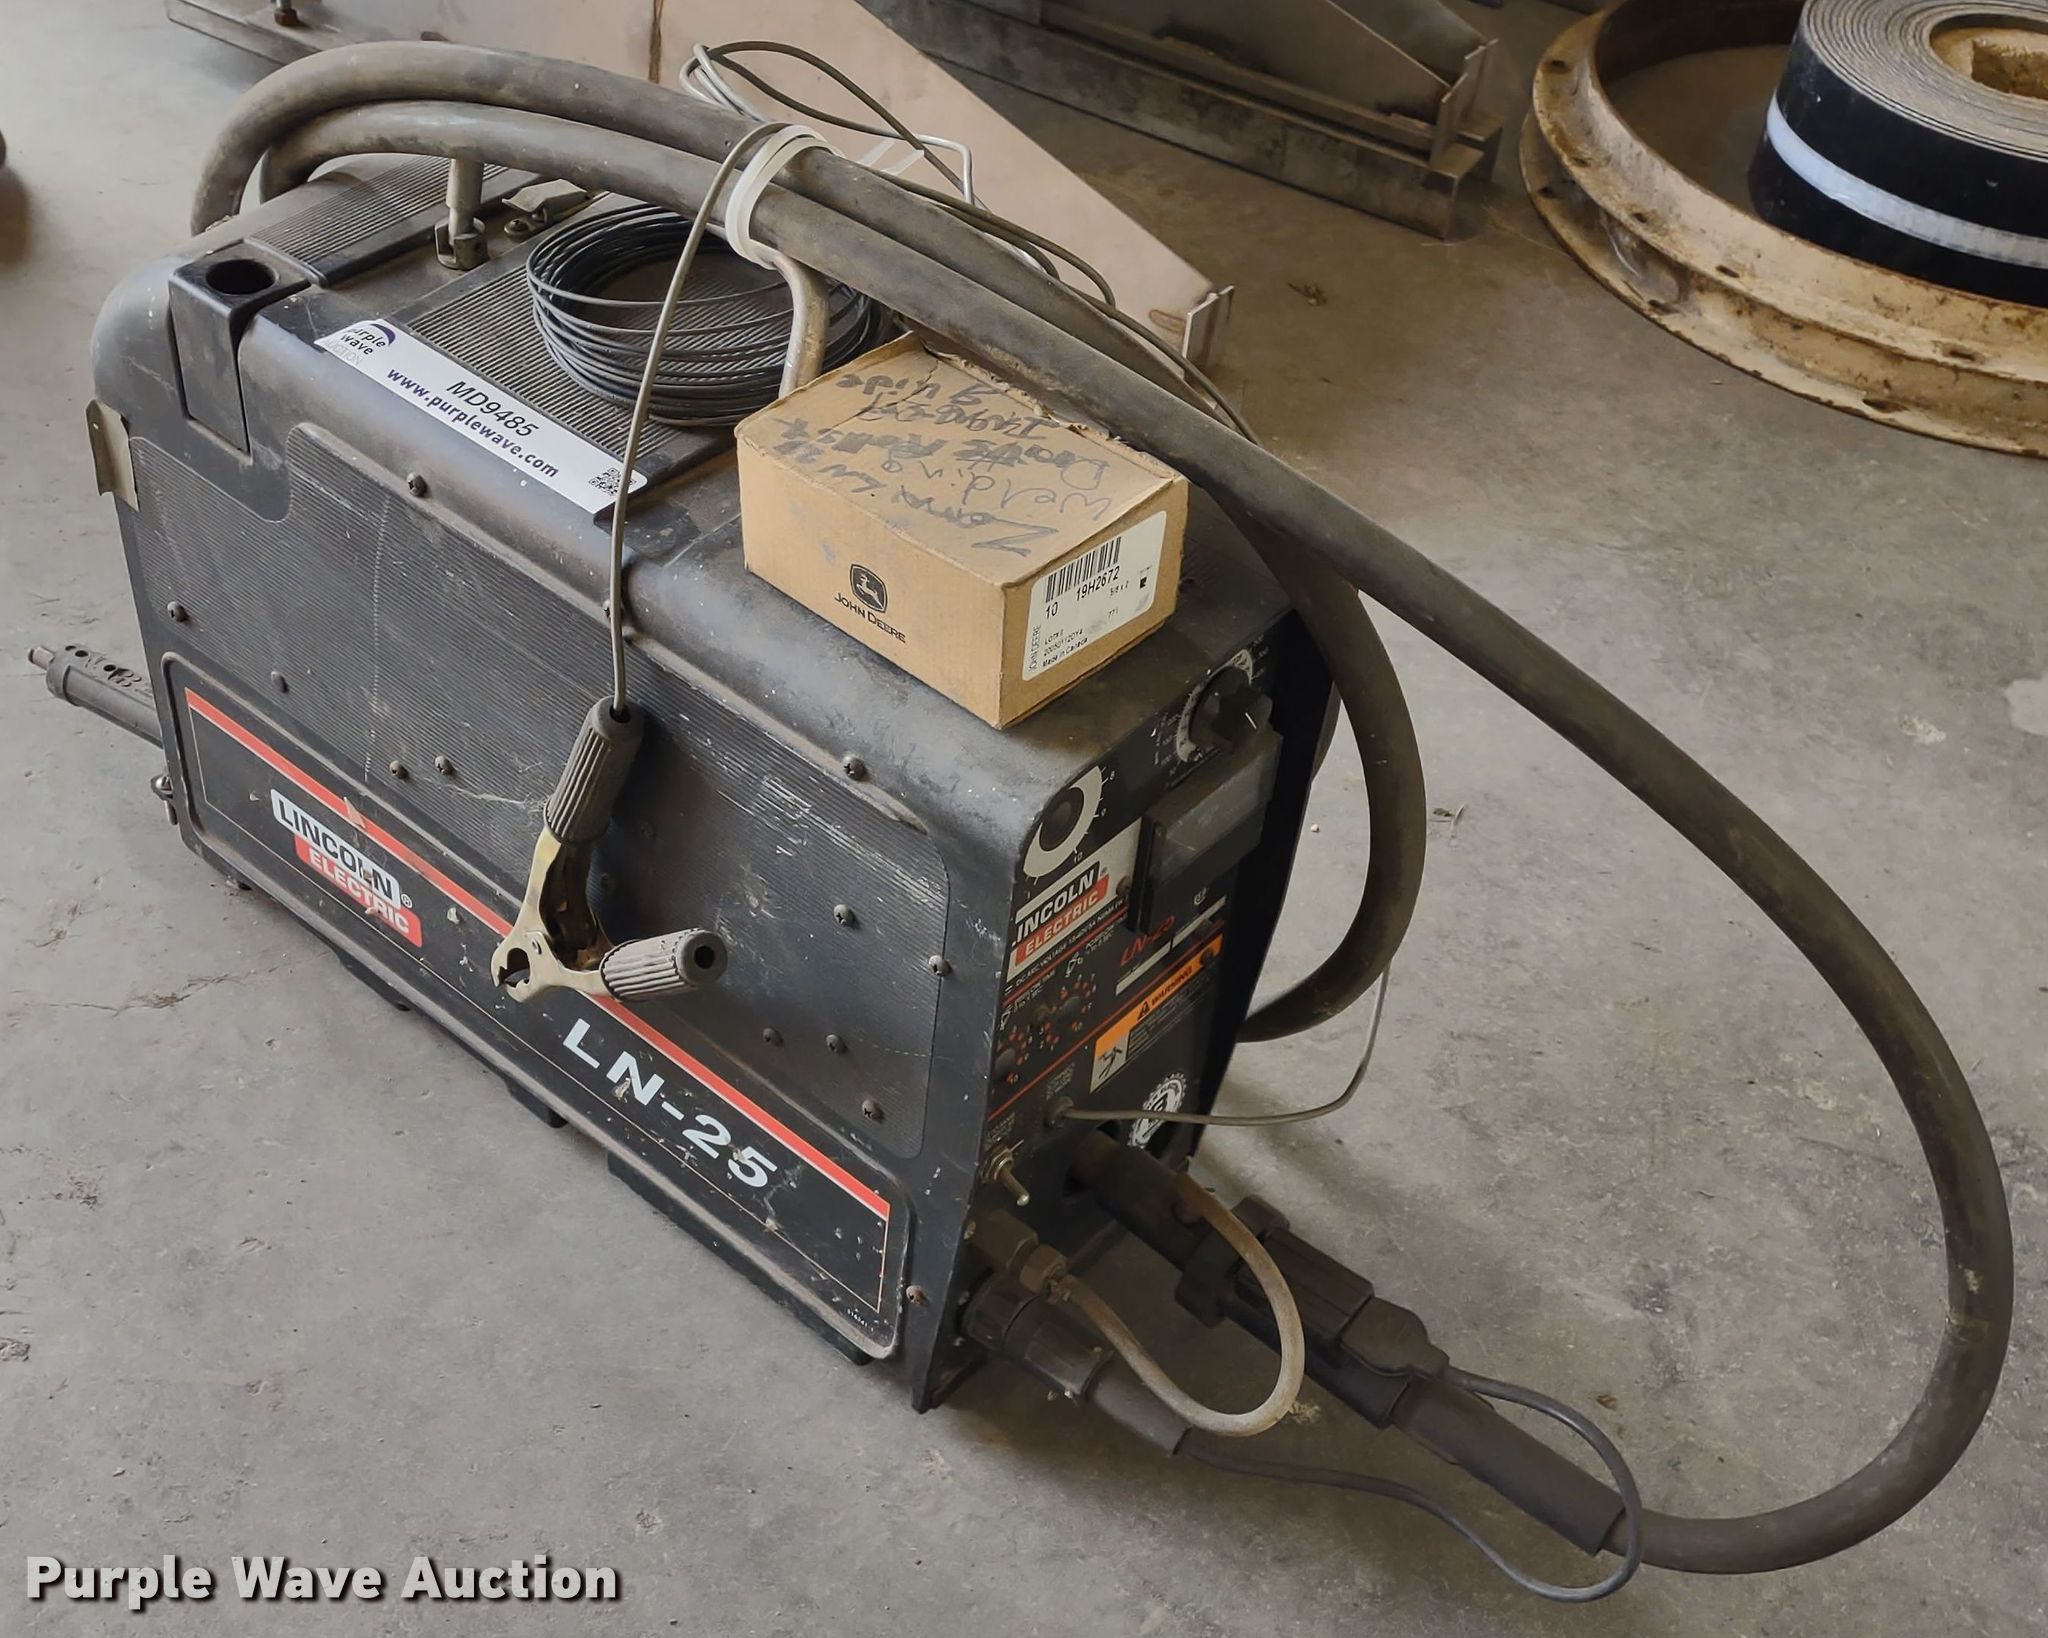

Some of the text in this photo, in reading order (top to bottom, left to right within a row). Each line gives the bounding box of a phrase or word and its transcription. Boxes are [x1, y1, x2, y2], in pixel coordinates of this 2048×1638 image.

[387, 368, 559, 478] www.purplewave.com
[446, 380, 540, 437] MD9485
[834, 593, 906, 644] JOHN DEERE
[1046, 565, 1120, 620] 10 19H2672
[1042, 654, 1058, 667] Made
[279, 799, 393, 899] LINCOLN
[309, 848, 409, 934] ELECTRIC
[1011, 869, 1095, 948] INCOLN
[1025, 890, 1099, 956] ELECTRIC
[562, 1018, 778, 1188] LN-25
